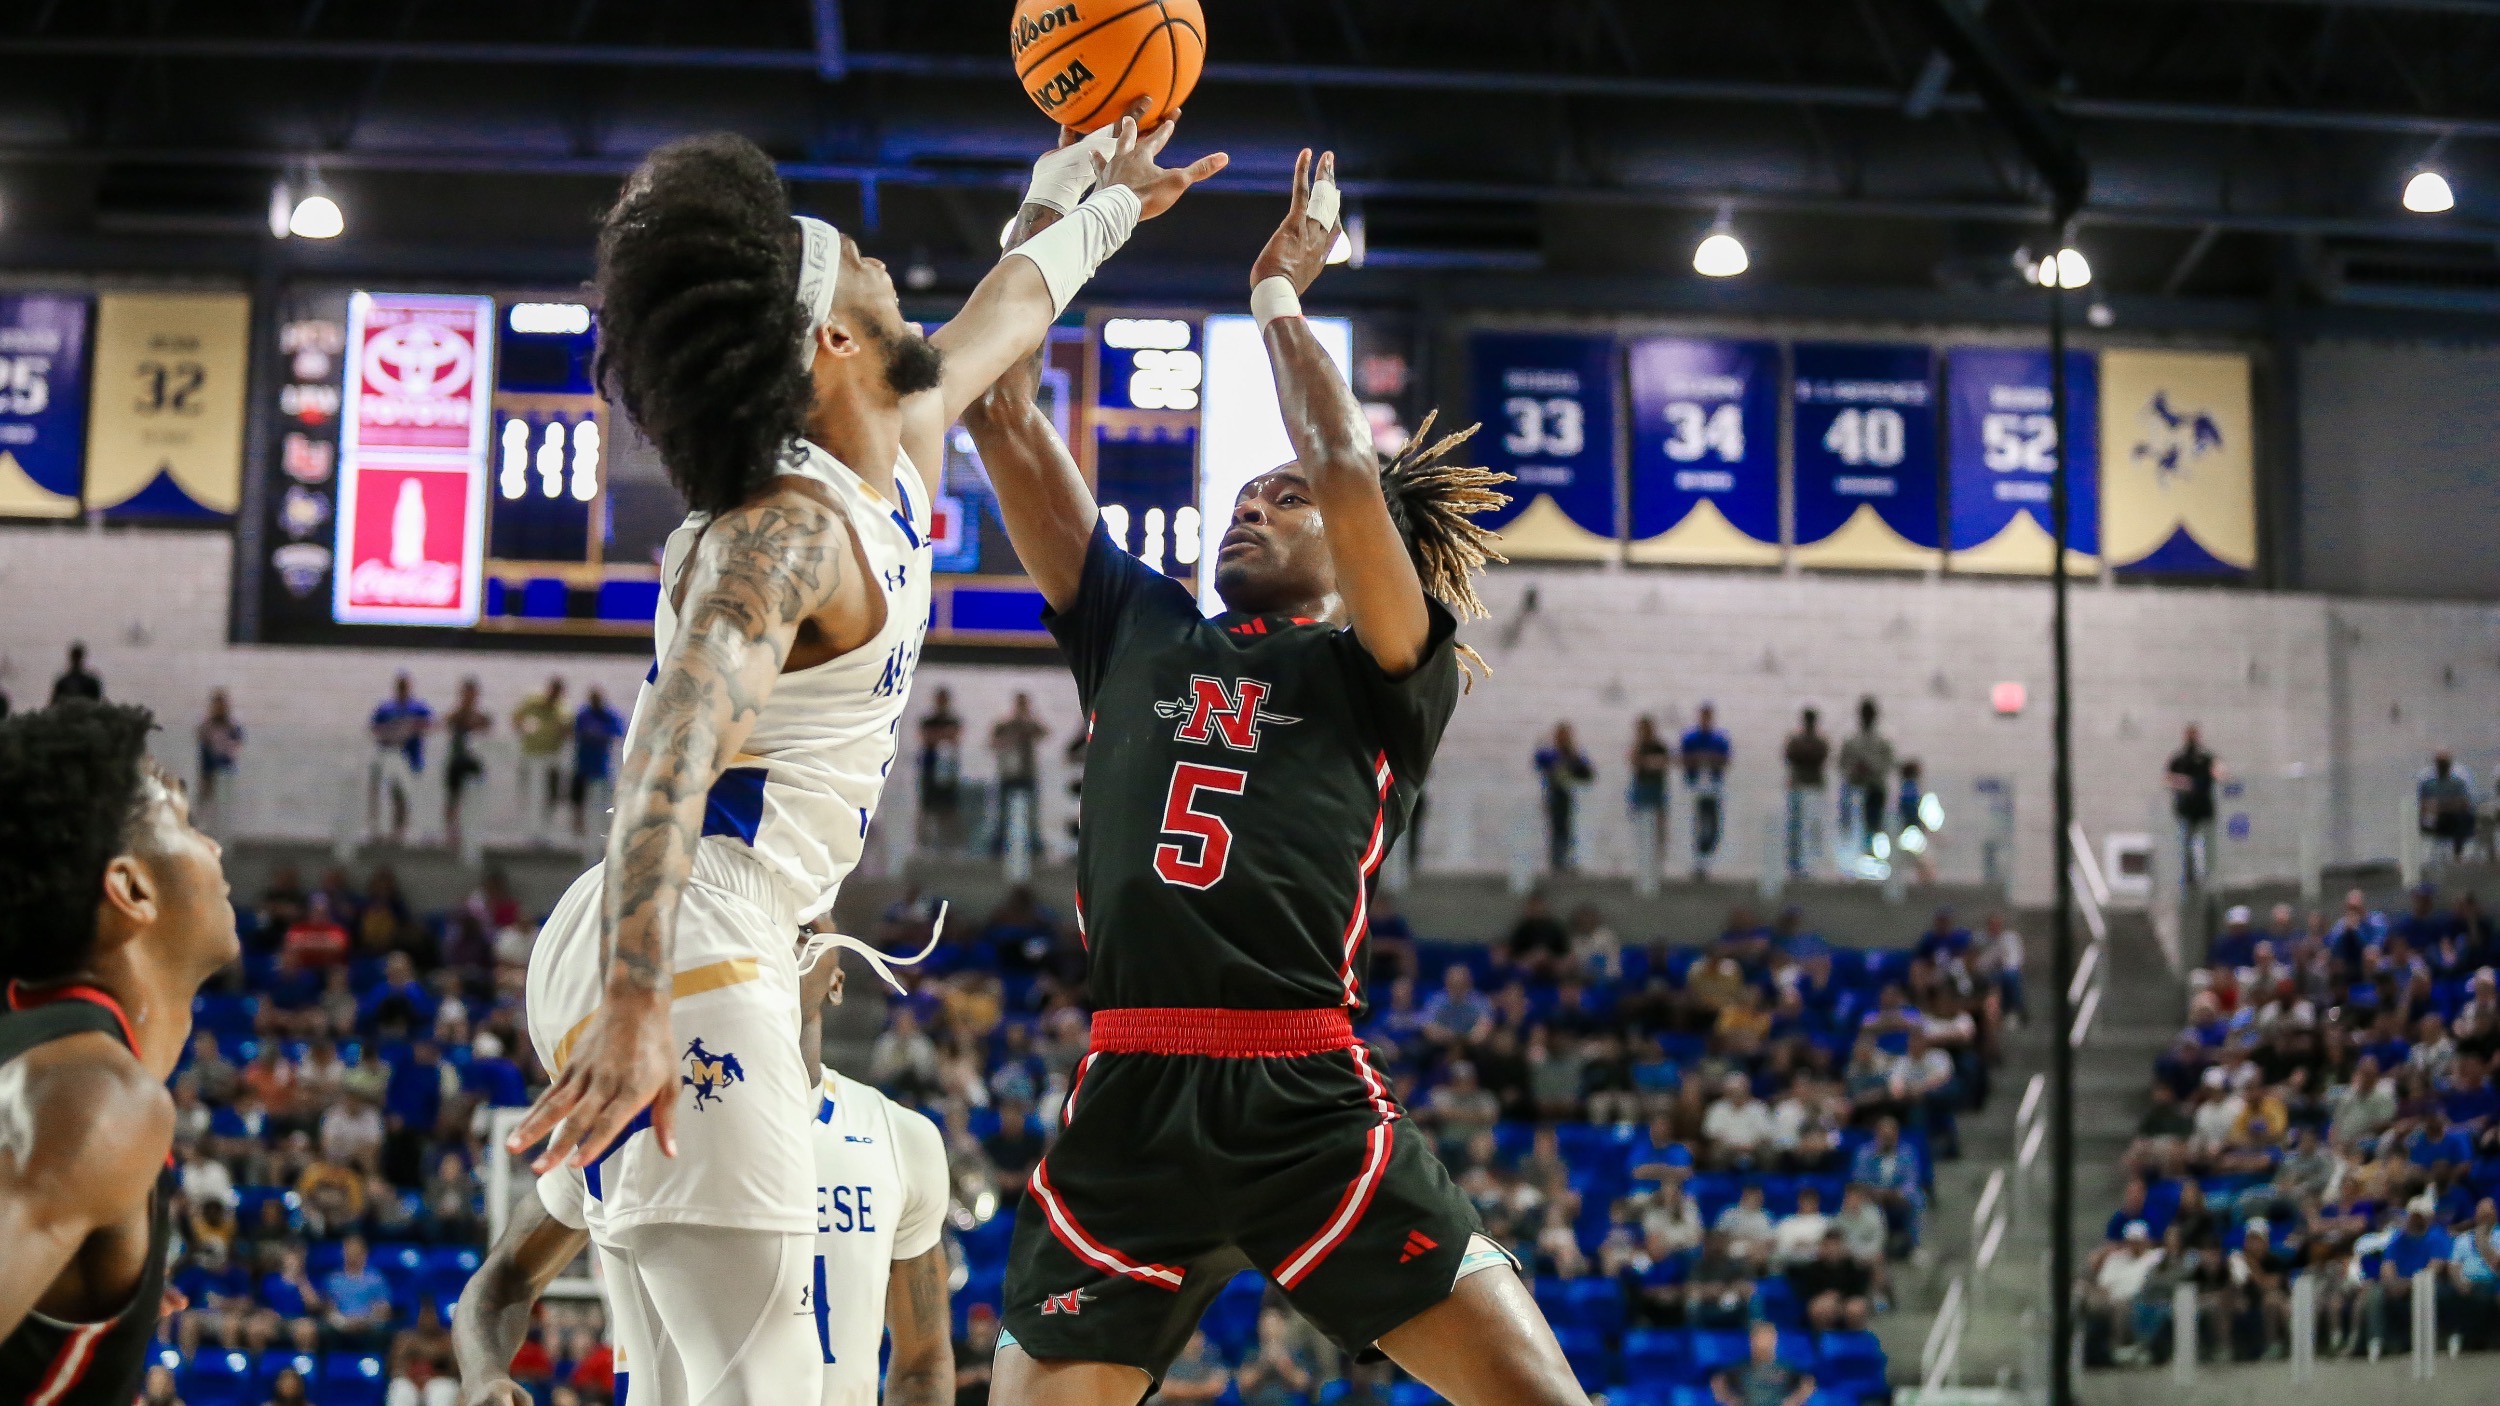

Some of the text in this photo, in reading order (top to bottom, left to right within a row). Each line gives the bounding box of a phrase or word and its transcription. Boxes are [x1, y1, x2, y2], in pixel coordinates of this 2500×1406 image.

[1031, 57, 1096, 113] NCAA
[135, 361, 205, 416] 32
[1502, 397, 1584, 457] 33
[1663, 401, 1745, 463] 34
[1823, 408, 1905, 467] 40
[1983, 412, 2058, 474] 52
[1173, 674, 1271, 752] N
[1153, 761, 1248, 891] 5
[817, 1186, 875, 1232] ESE
